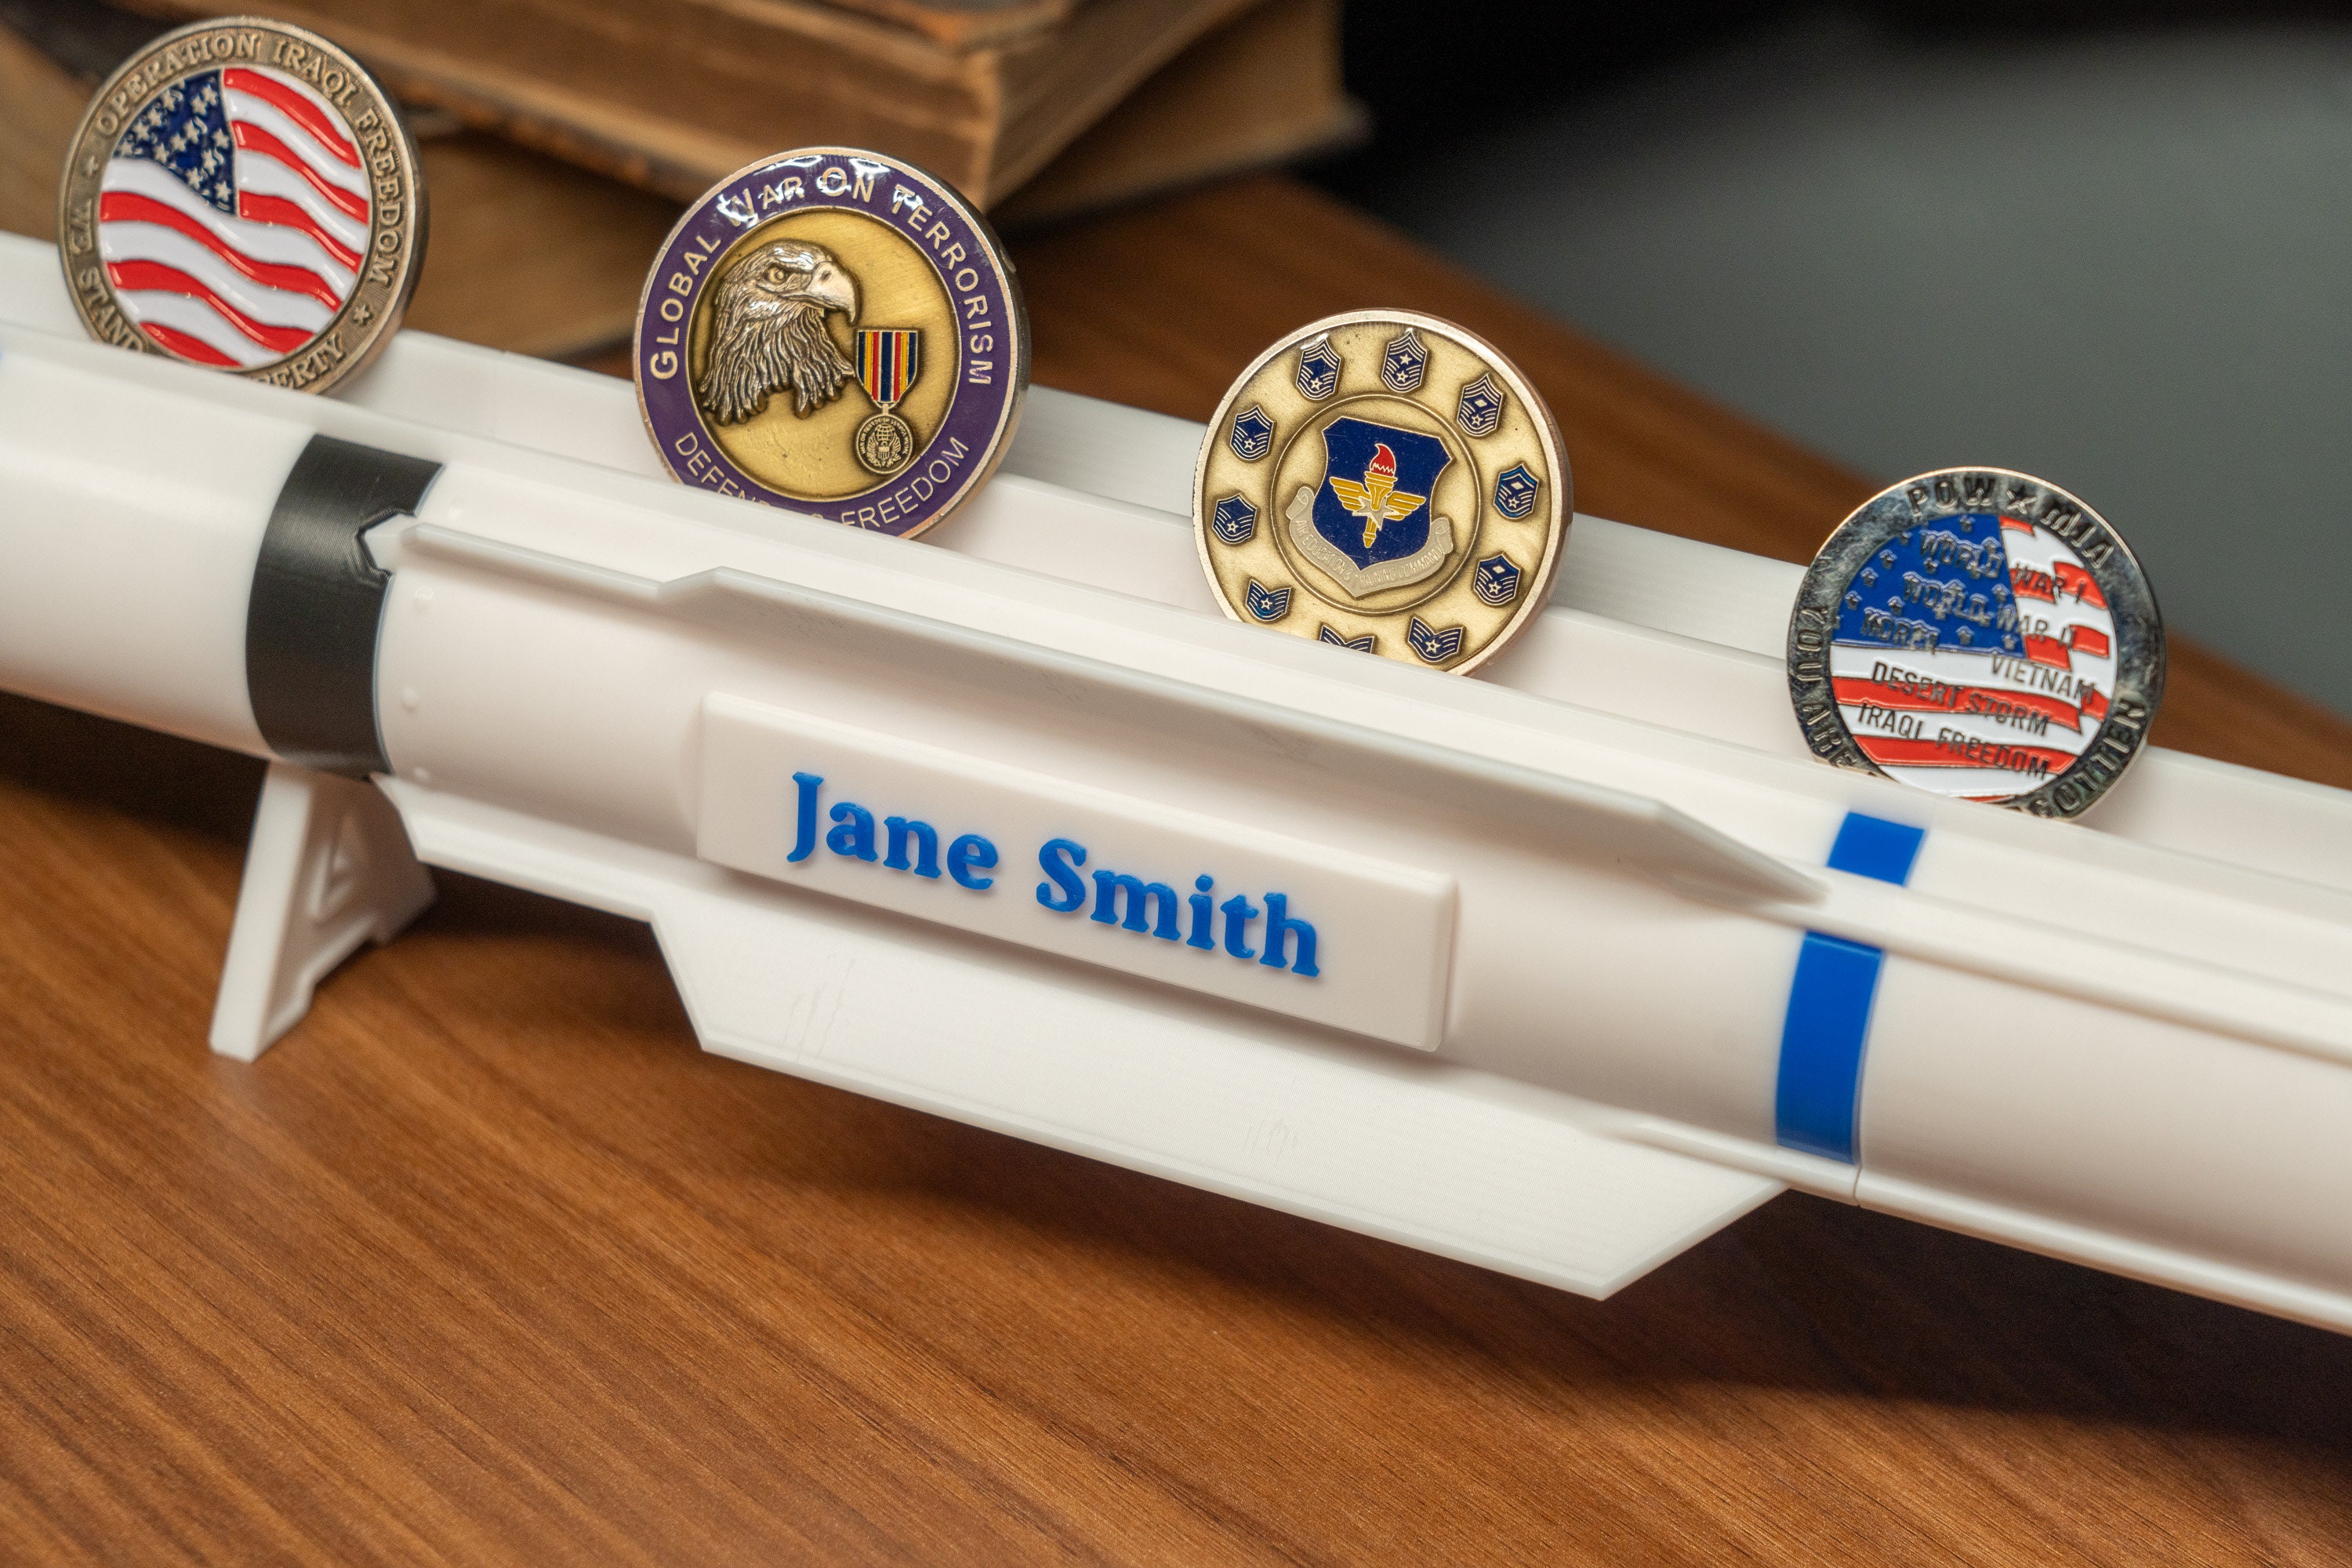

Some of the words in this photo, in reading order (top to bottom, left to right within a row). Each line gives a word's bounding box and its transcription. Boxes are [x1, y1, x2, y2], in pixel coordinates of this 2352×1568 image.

[96, 31, 262, 136] OPERATION
[274, 39, 360, 106] IRAQI
[356, 107, 401, 287] FREEDOM
[649, 237, 721, 380] GLOBAL
[718, 176, 805, 228] WAR
[822, 166, 875, 203] ON
[891, 183, 993, 386] TERRORISM
[79, 267, 143, 351] STAND
[257, 331, 344, 390] ERTY
[840, 436, 970, 529] FREEDOM
[1906, 475, 1997, 517] POW
[1919, 530, 2004, 579] WORLD
[2014, 562, 2066, 599] WAR
[2075, 581, 2085, 604] I
[2040, 499, 2114, 569] MIA
[1796, 606, 1828, 682] YOU
[1860, 607, 1941, 655] KOREA
[1903, 571, 1989, 621] WORLD
[1997, 604, 2049, 642] WAR
[1871, 661, 1962, 708] DESERT
[1966, 692, 2050, 736] STORM
[1990, 652, 2095, 704] VIETNAM
[1857, 702, 1924, 741] IRAQI
[1936, 726, 2050, 781] FREEDOM
[786, 770, 1000, 891] Jane
[1034, 837, 1322, 978] Smith
